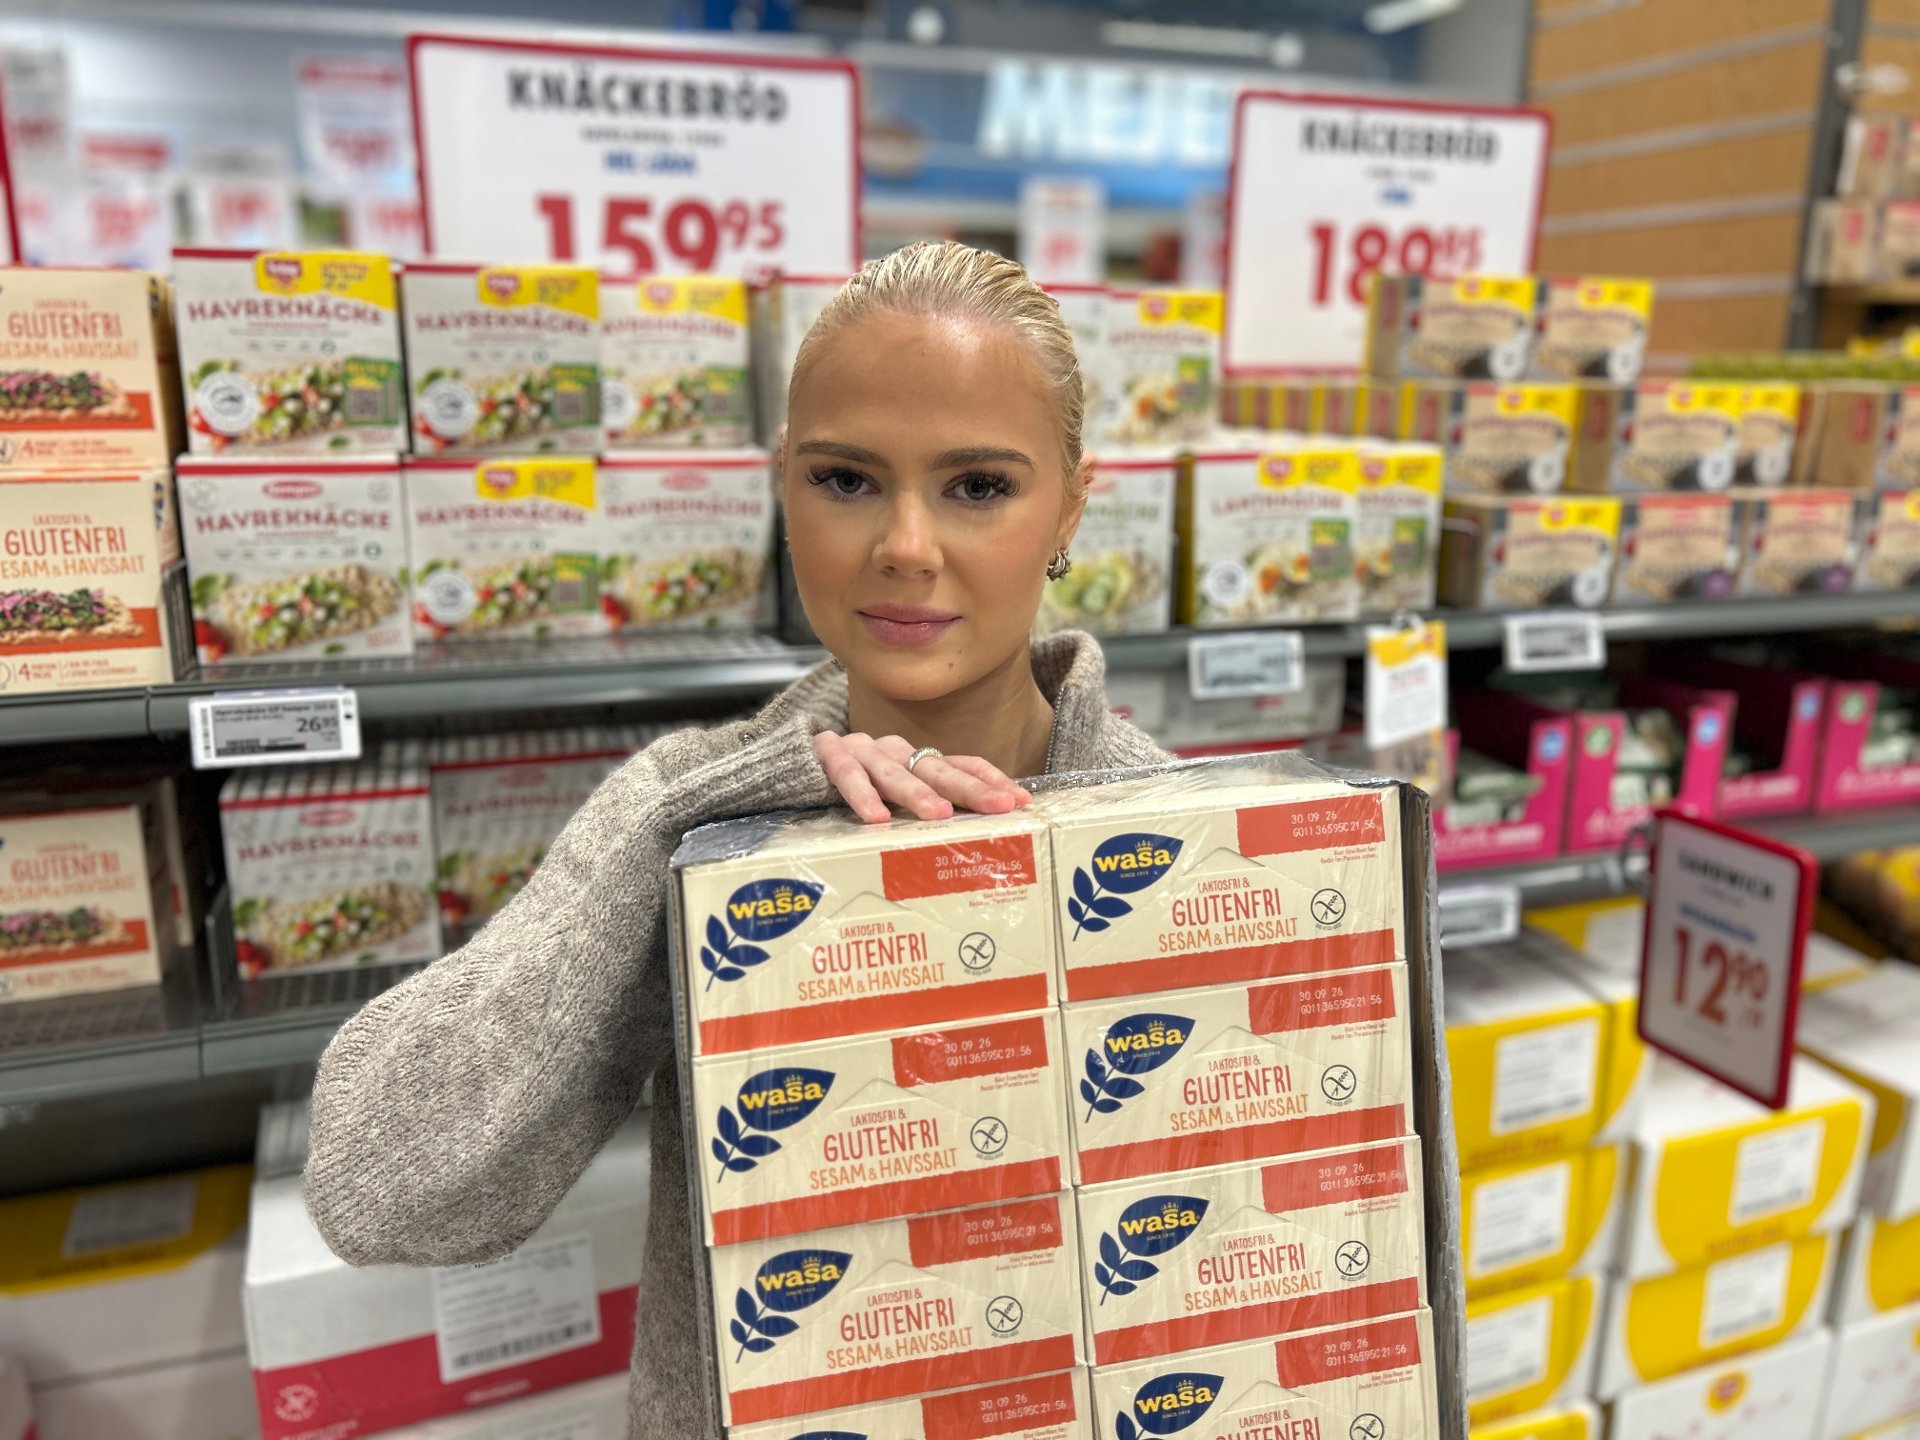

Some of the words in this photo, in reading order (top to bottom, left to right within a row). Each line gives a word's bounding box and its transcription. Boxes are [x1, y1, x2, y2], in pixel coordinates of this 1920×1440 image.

[509, 61, 788, 121] KNÄCKEBRÖD
[188, 293, 384, 326] HAVREKNÄCKE
[8, 311, 123, 338] GLUTENFRI
[195, 503, 392, 532] HAVREKNÄCKE
[5, 526, 127, 556] GLUTENFRI
[52, 566, 62, 577] &
[65, 555, 145, 576] HAVSSALT
[1291, 813, 1304, 825] 30
[935, 856, 948, 867] 30
[1094, 849, 1172, 872] wasa
[1197, 877, 1240, 893] LAKTOSFRI
[1242, 876, 1250, 888] &
[729, 893, 813, 921] wasa
[1171, 887, 1282, 928] GLUTENFRI
[840, 923, 886, 939] LAKTOSFRI
[887, 922, 895, 933] &
[1159, 928, 1212, 953] SESAM
[1213, 932, 1222, 945] &
[1226, 917, 1298, 945] HAVSSALT
[812, 931, 928, 975] GLUTENFRI
[799, 977, 854, 1001] SESAM
[856, 980, 867, 993] &
[868, 962, 946, 992] HAVSSALT
[1299, 991, 1311, 1001] 30
[944, 1043, 957, 1053] 30
[1106, 1029, 1184, 1054] wasa
[1208, 1056, 1251, 1072] LAKTOSFRI
[1252, 1055, 1261, 1066] &
[740, 1080, 824, 1110] wasa
[1183, 1065, 1293, 1106] GLUTENFRI
[851, 1110, 896, 1127] LAKTOSFRI
[897, 1108, 907, 1119] &
[1170, 1107, 1223, 1132] SESAM
[1225, 1111, 1234, 1124] &
[1236, 1093, 1309, 1123] HAVSSALT
[823, 1117, 940, 1162] GLUTENFRI
[810, 1165, 866, 1190] SESAM
[868, 1168, 878, 1181] &
[880, 1148, 957, 1178] HAVSSALT
[1318, 1168, 1331, 1178] 30
[966, 1221, 978, 1232] 30
[1120, 1208, 1197, 1237] wasa
[1223, 1234, 1266, 1251] LAKTOSFRI
[1267, 1233, 1275, 1244] &
[758, 1262, 841, 1292] wasa
[1197, 1242, 1306, 1286] GLUTENFRI
[867, 1290, 913, 1307] LAKTOSFRI
[913, 1288, 922, 1299] &
[1184, 1287, 1237, 1312] SESAM
[1239, 1291, 1249, 1303] &
[1250, 1271, 1323, 1302] HAVSSALT
[839, 1298, 955, 1342] GLUTENFRI
[826, 1343, 881, 1369] SESAM
[885, 1346, 894, 1359] &
[897, 1326, 973, 1357] HAVSSALT
[1324, 1344, 1336, 1353] 30
[980, 1400, 993, 1410] 30
[1136, 1384, 1213, 1415] wasa
[1239, 1410, 1281, 1428] LAKTOSFRI
[1282, 1409, 1291, 1420] &
